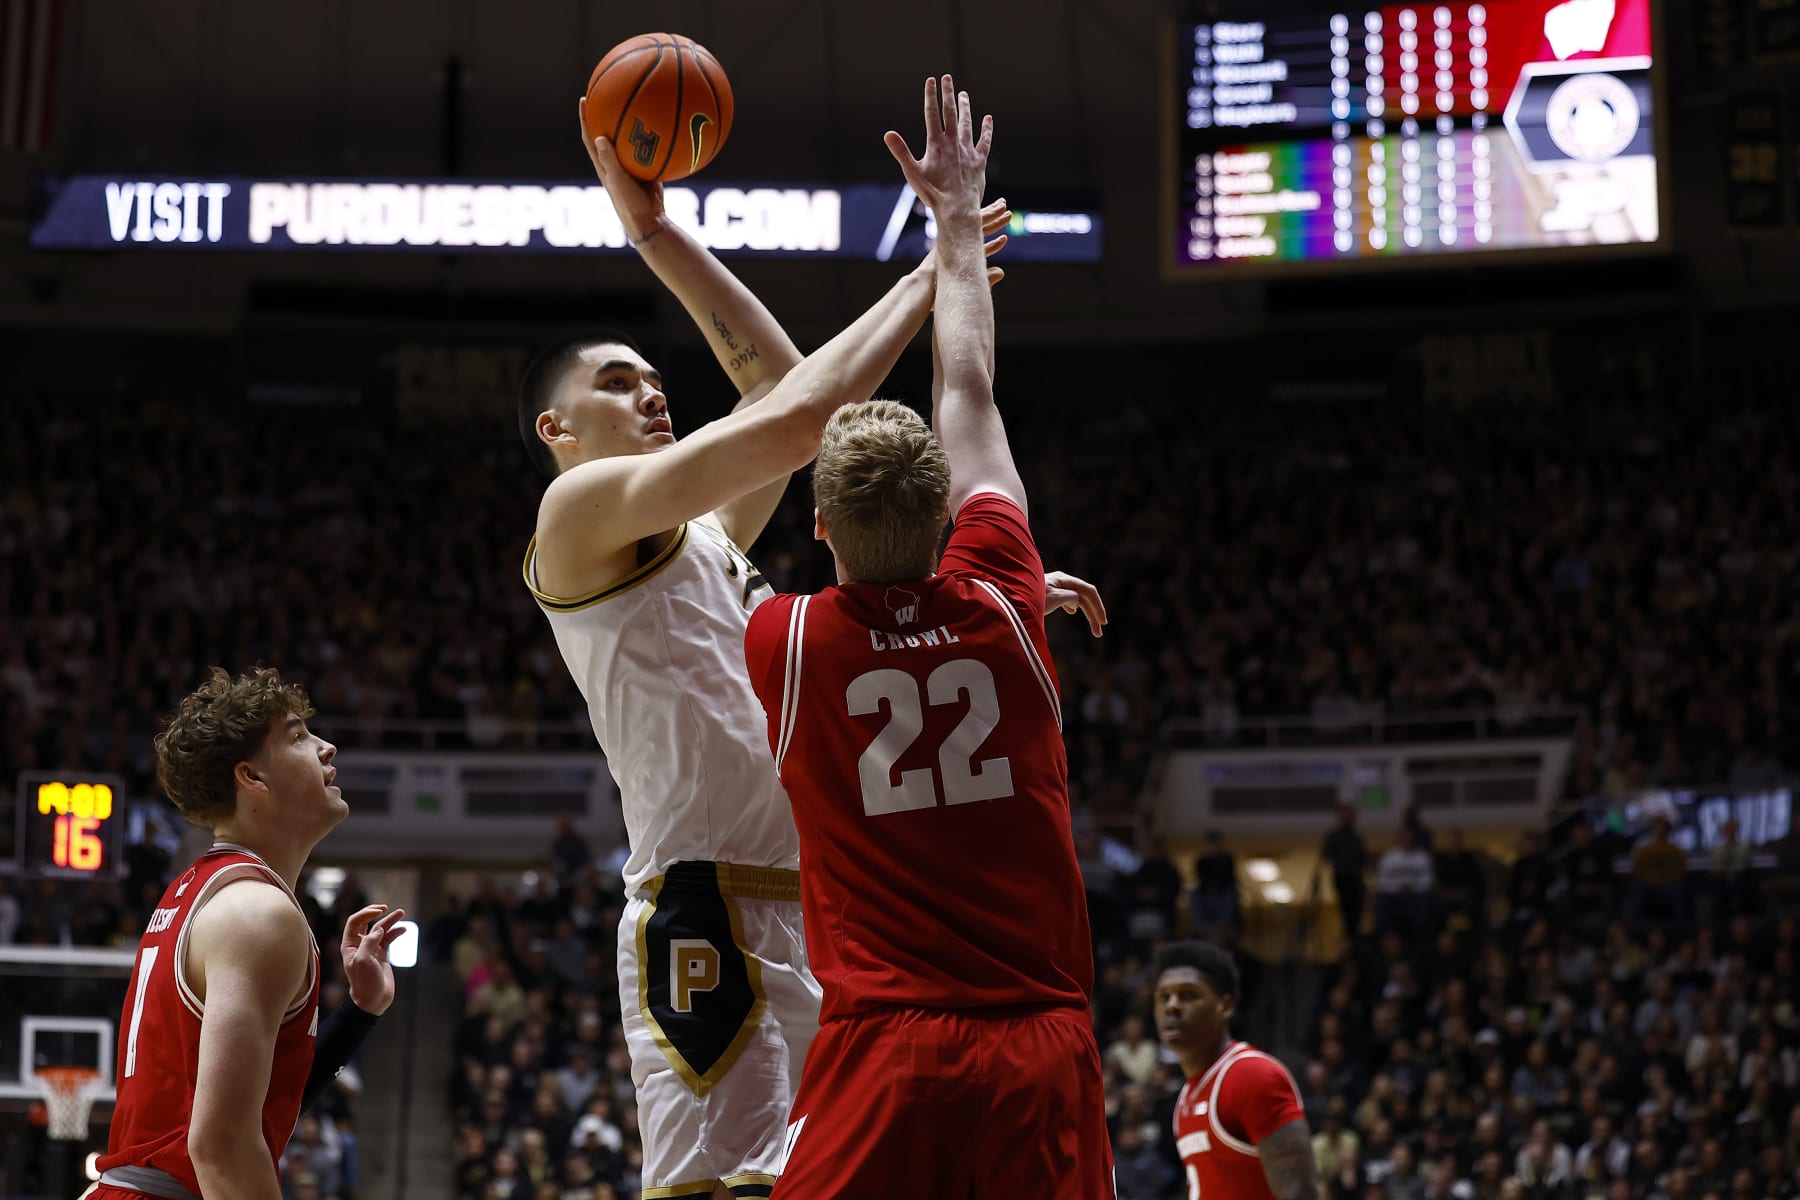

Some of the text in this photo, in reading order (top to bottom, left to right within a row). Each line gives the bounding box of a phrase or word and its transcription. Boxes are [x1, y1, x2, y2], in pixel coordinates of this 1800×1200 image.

[105, 182, 231, 243] VISIT
[845, 658, 1015, 817] 22
[54, 815, 102, 870] 16
[669, 938, 720, 1013] P
